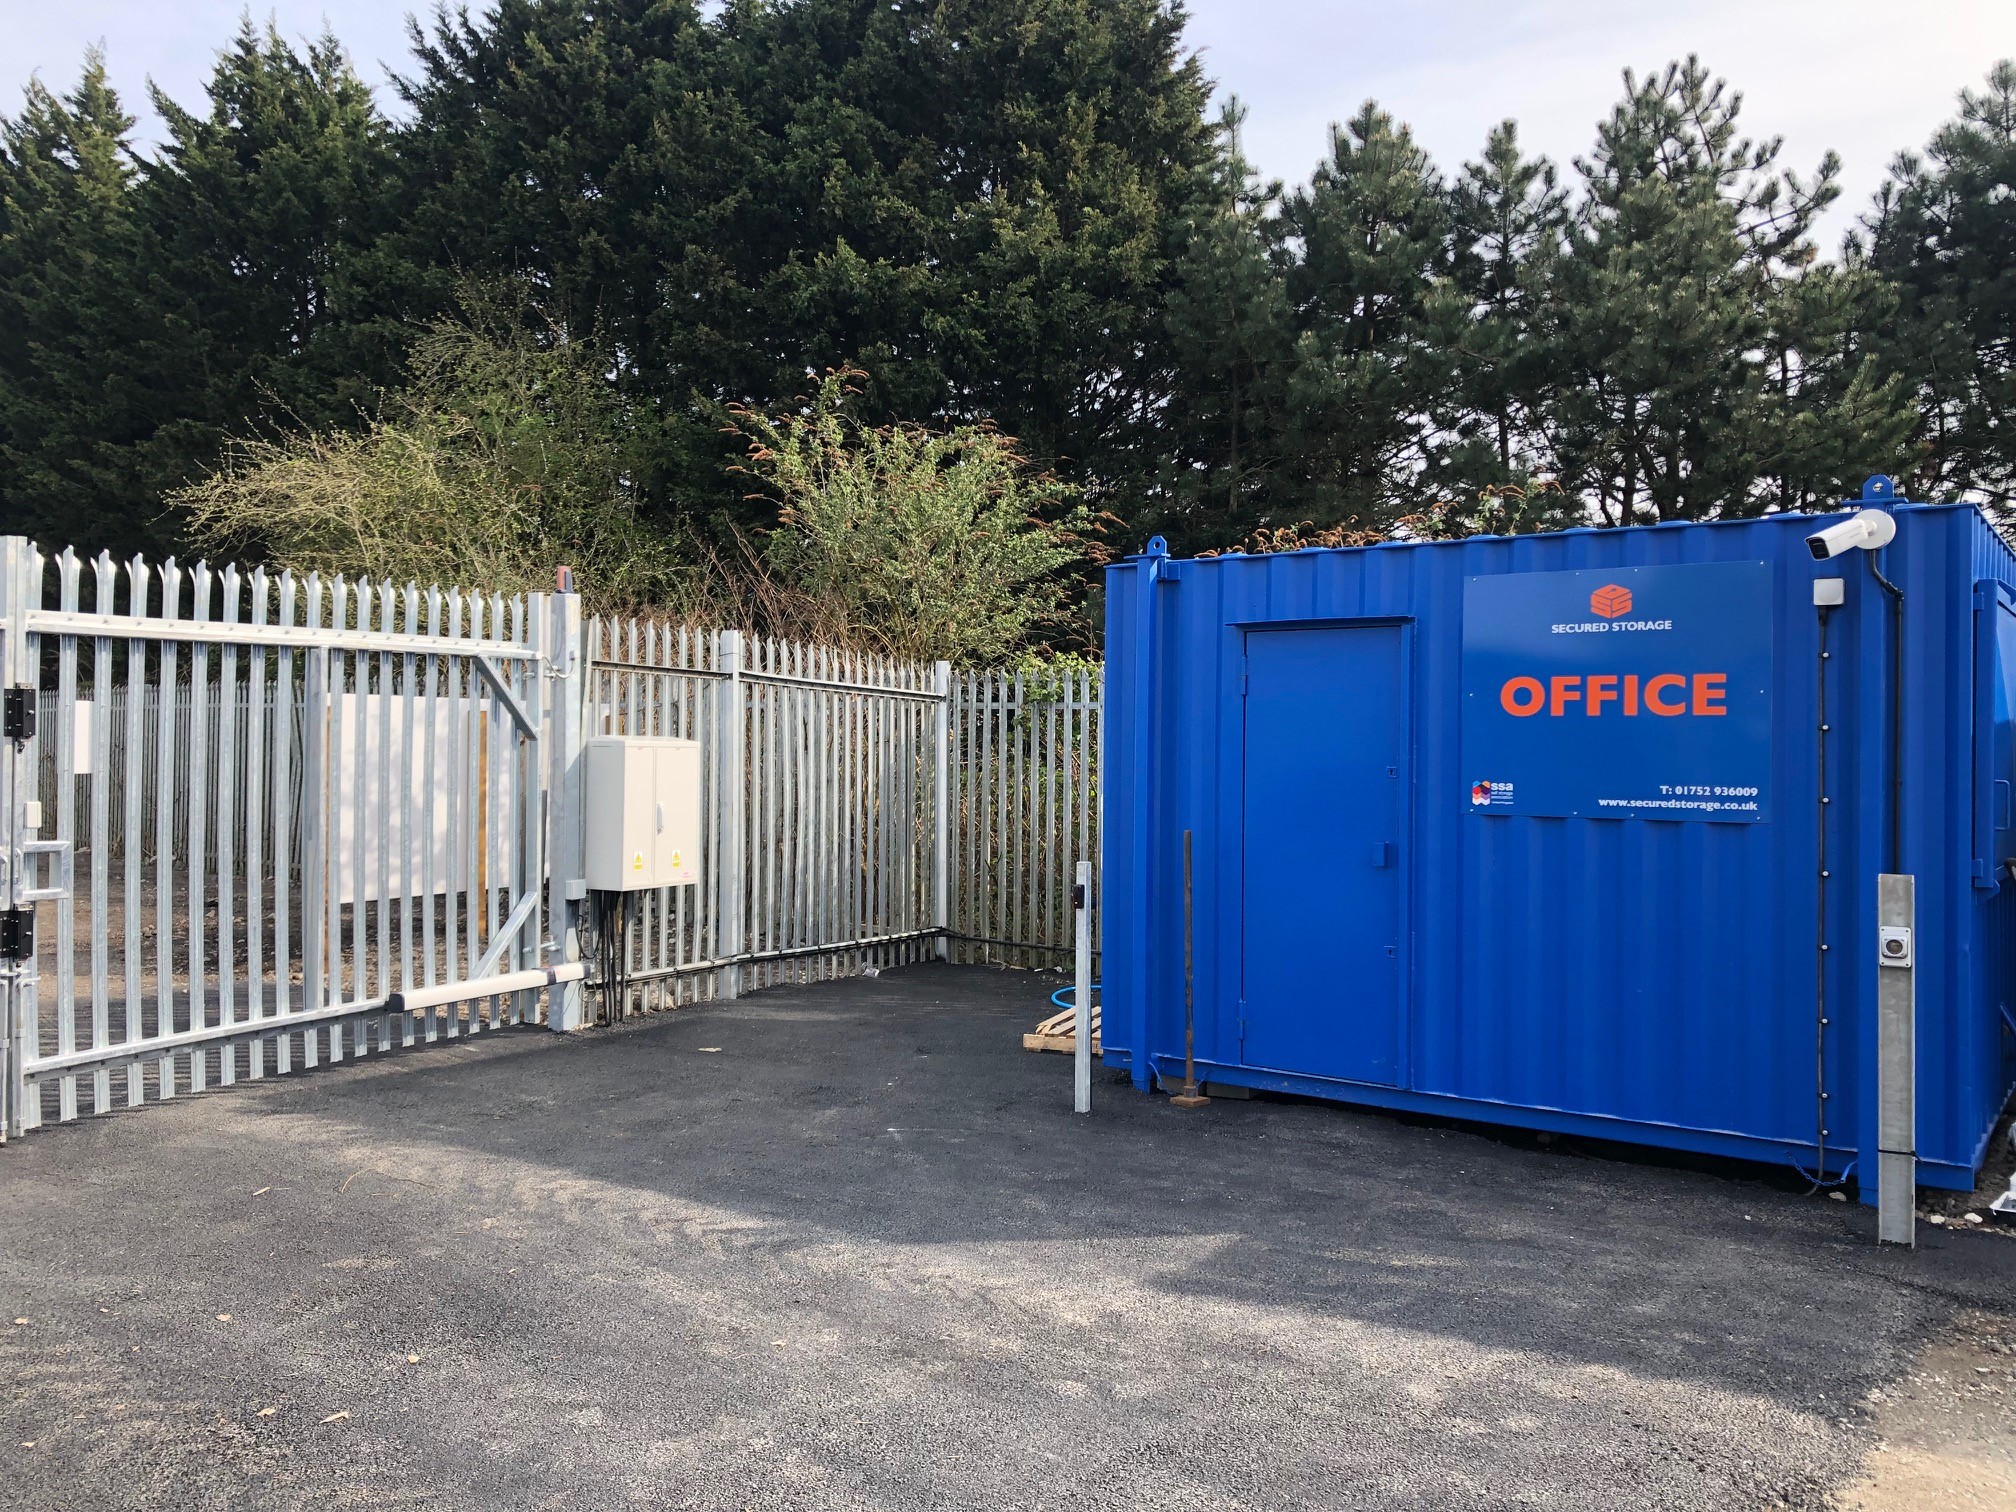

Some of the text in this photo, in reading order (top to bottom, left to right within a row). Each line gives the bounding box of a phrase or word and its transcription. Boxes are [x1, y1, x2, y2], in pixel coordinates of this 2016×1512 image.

[1551, 620, 1672, 634] SECURED STORAGE
[1500, 673, 1727, 717] OFFICE
[1490, 782, 1514, 791] ssa
[1659, 785, 1758, 796] T: 01752 936009
[1598, 799, 1758, 811] www.securedstorage.co.uk
